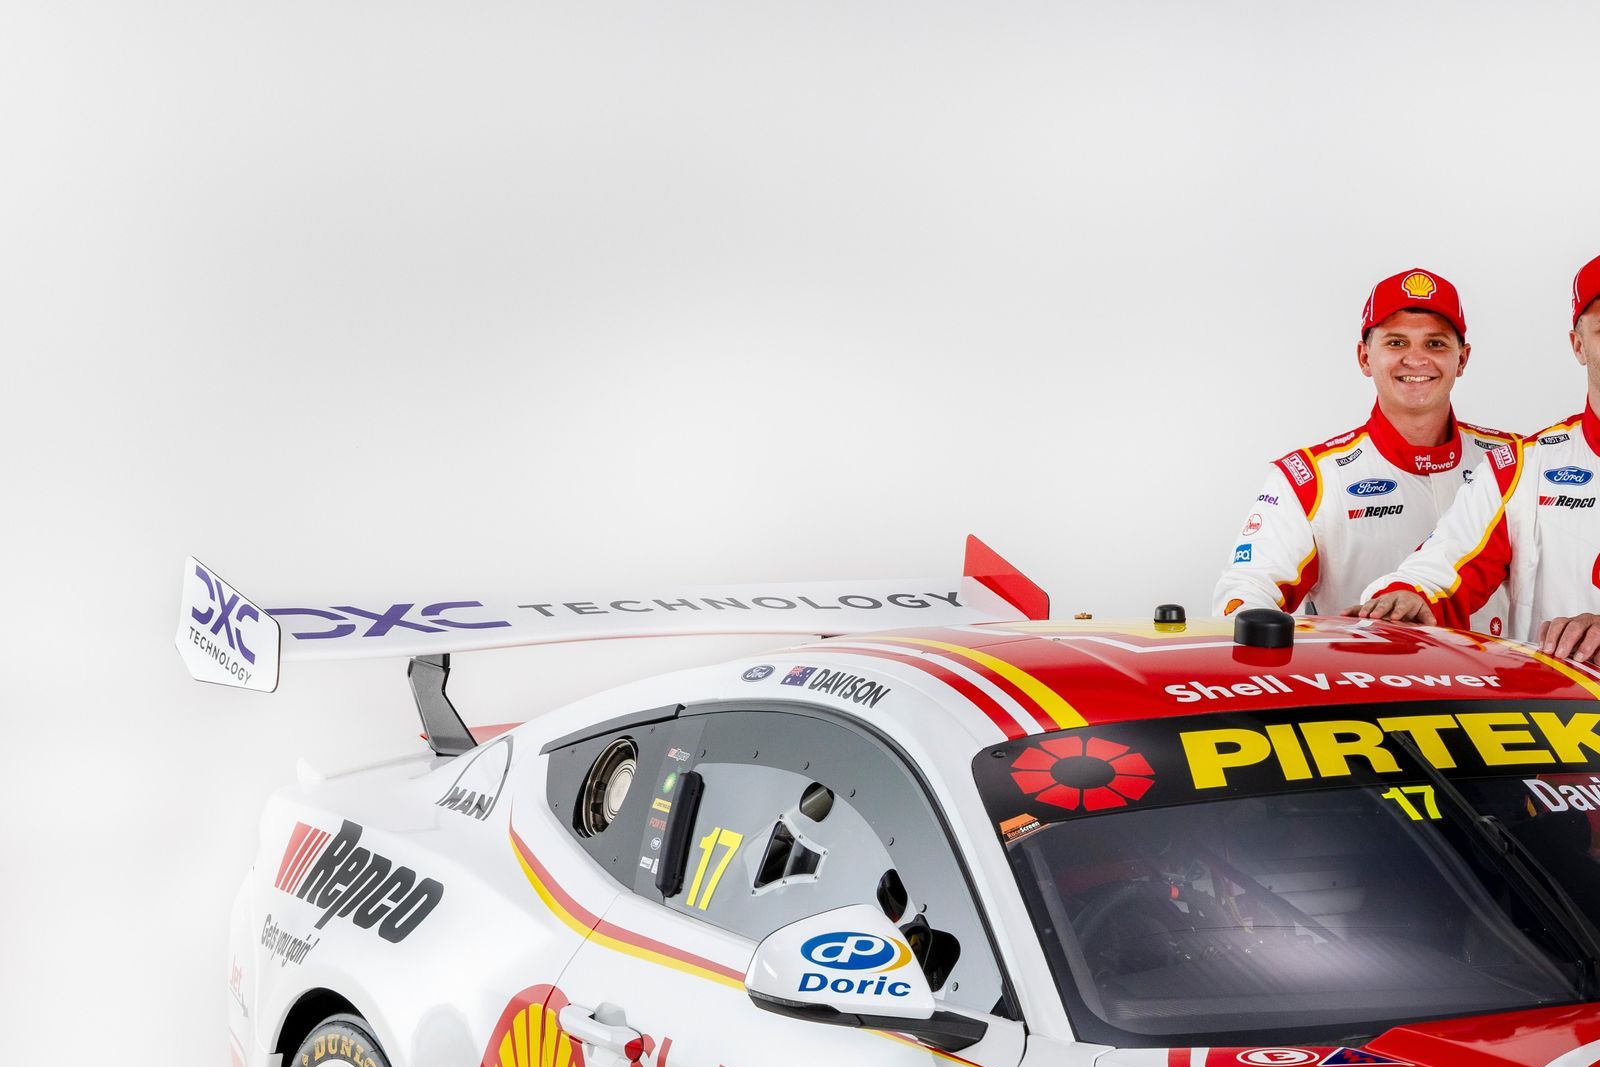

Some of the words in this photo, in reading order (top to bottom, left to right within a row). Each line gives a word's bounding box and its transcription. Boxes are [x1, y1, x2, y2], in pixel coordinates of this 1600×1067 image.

[1415, 460, 1454, 471] V-Power
[1364, 504, 1404, 519] Repco
[1555, 495, 1596, 510] Repco
[191, 564, 260, 665] DXC
[263, 600, 512, 640] DXC
[518, 591, 964, 617] TECHNOLOGY
[189, 626, 252, 686] TECHNOLOGY
[808, 669, 891, 708] DAVISON
[1164, 674, 1294, 704] Shell
[1289, 671, 1501, 692] V-Power
[441, 786, 494, 821] MAN
[1381, 785, 1443, 821] 17
[296, 819, 444, 944] Repco
[686, 827, 744, 911] 17
[261, 913, 279, 950] Gets
[798, 972, 912, 997] Doric
